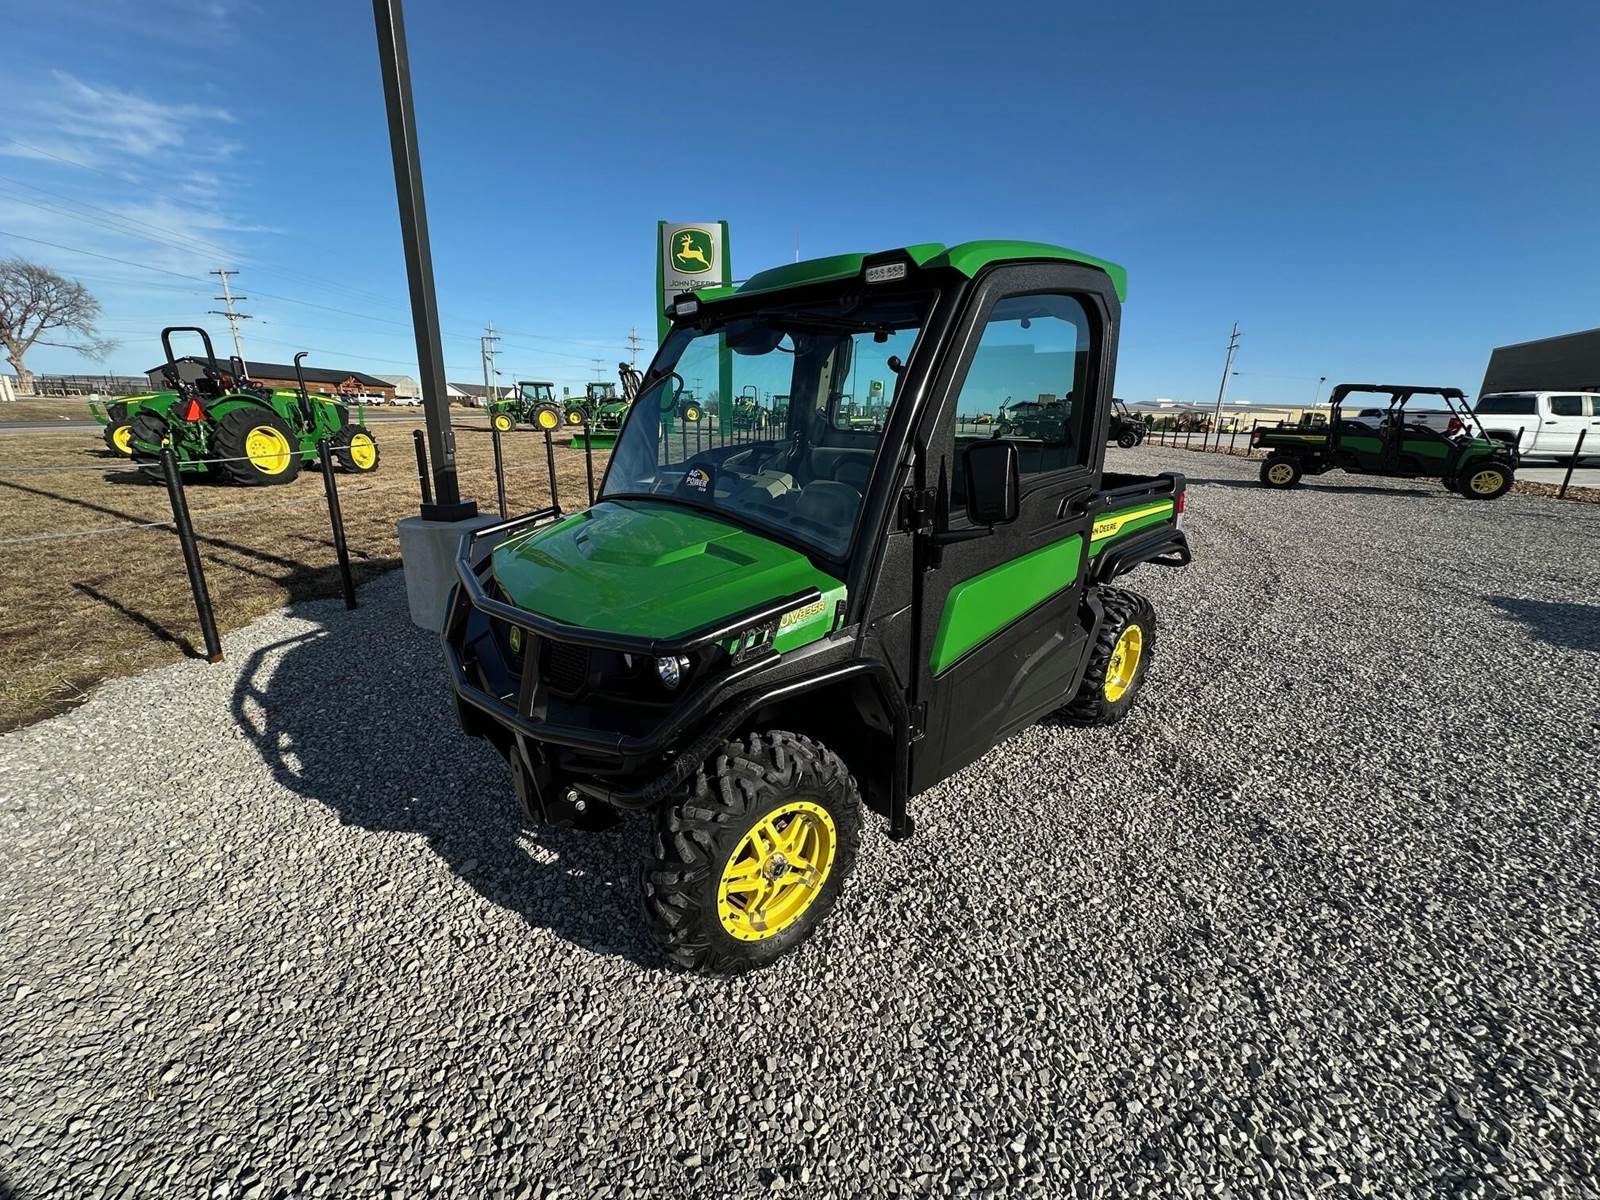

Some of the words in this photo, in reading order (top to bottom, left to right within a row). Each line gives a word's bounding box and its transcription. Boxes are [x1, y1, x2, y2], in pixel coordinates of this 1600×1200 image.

[686, 477, 708, 487] POWER
[1099, 522, 1117, 534] DEERE
[779, 602, 826, 628] UV835R
